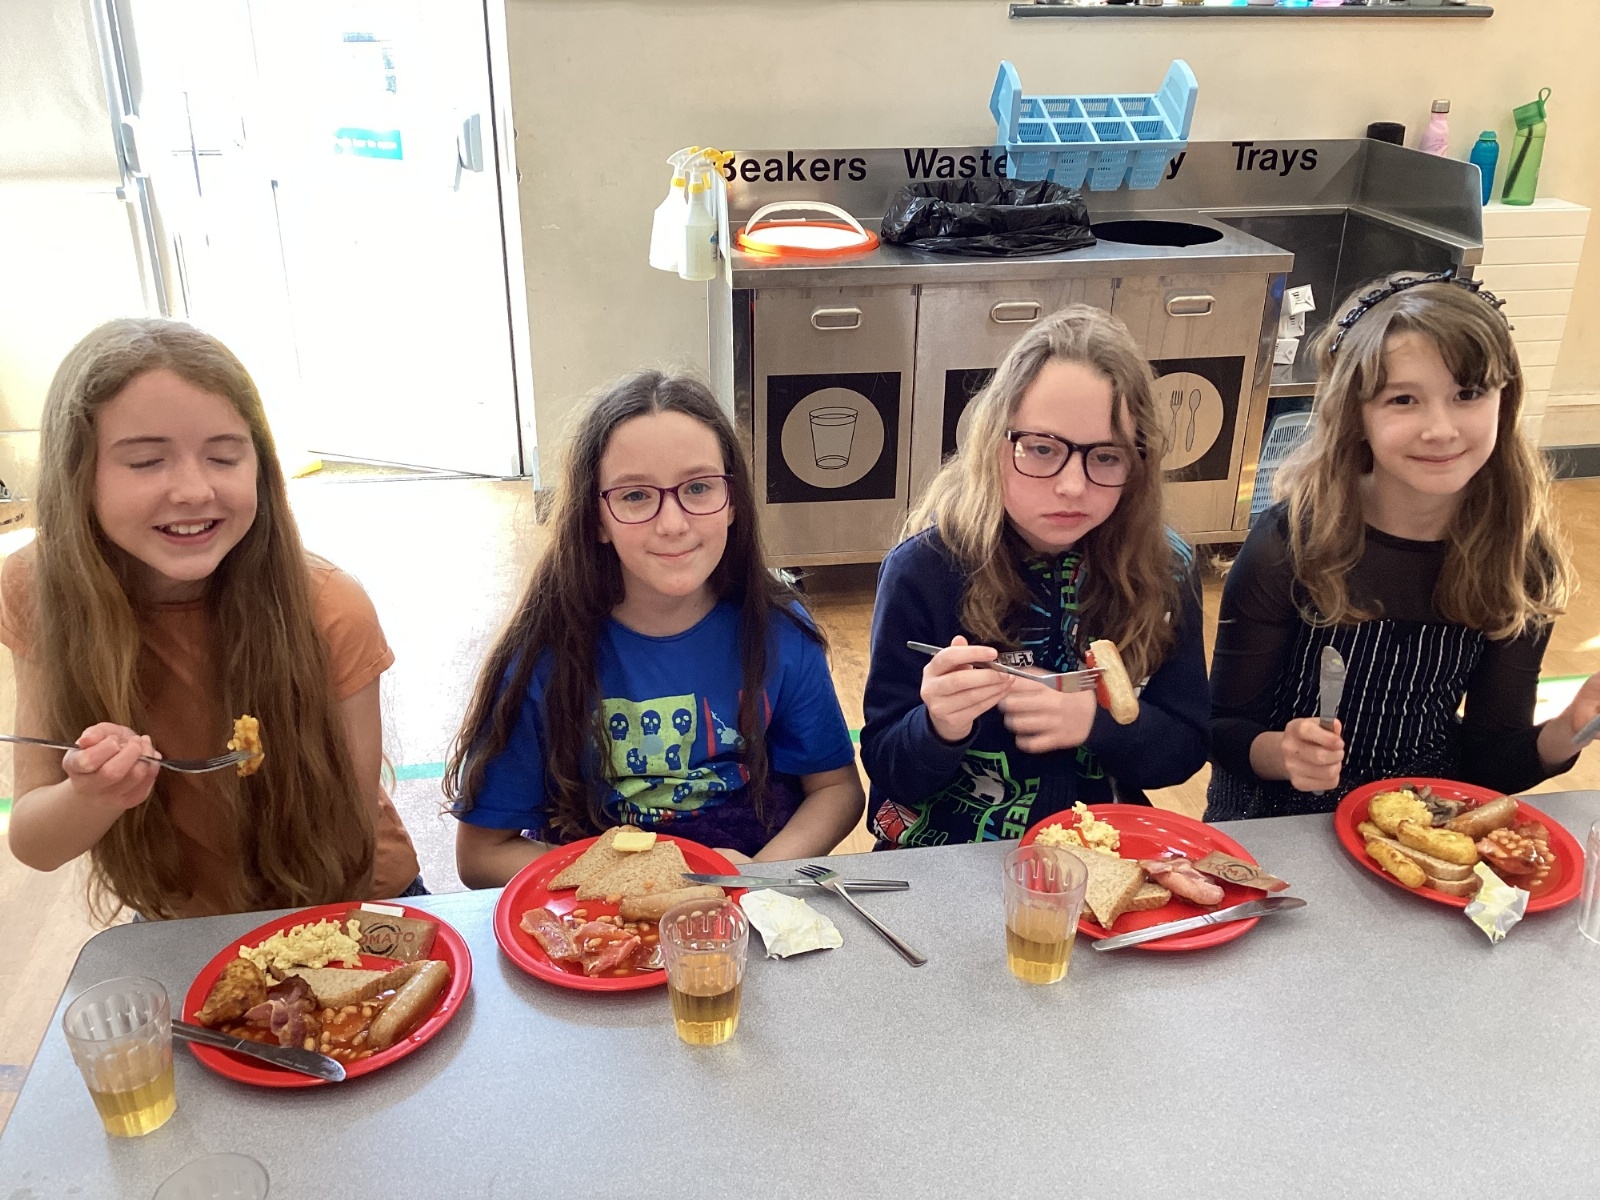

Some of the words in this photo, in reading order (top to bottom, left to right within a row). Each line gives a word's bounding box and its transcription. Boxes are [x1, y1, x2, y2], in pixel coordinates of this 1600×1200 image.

[903, 148, 1008, 179] Waste
[1231, 141, 1318, 177] Trays
[360, 931, 415, 946] OMATO
